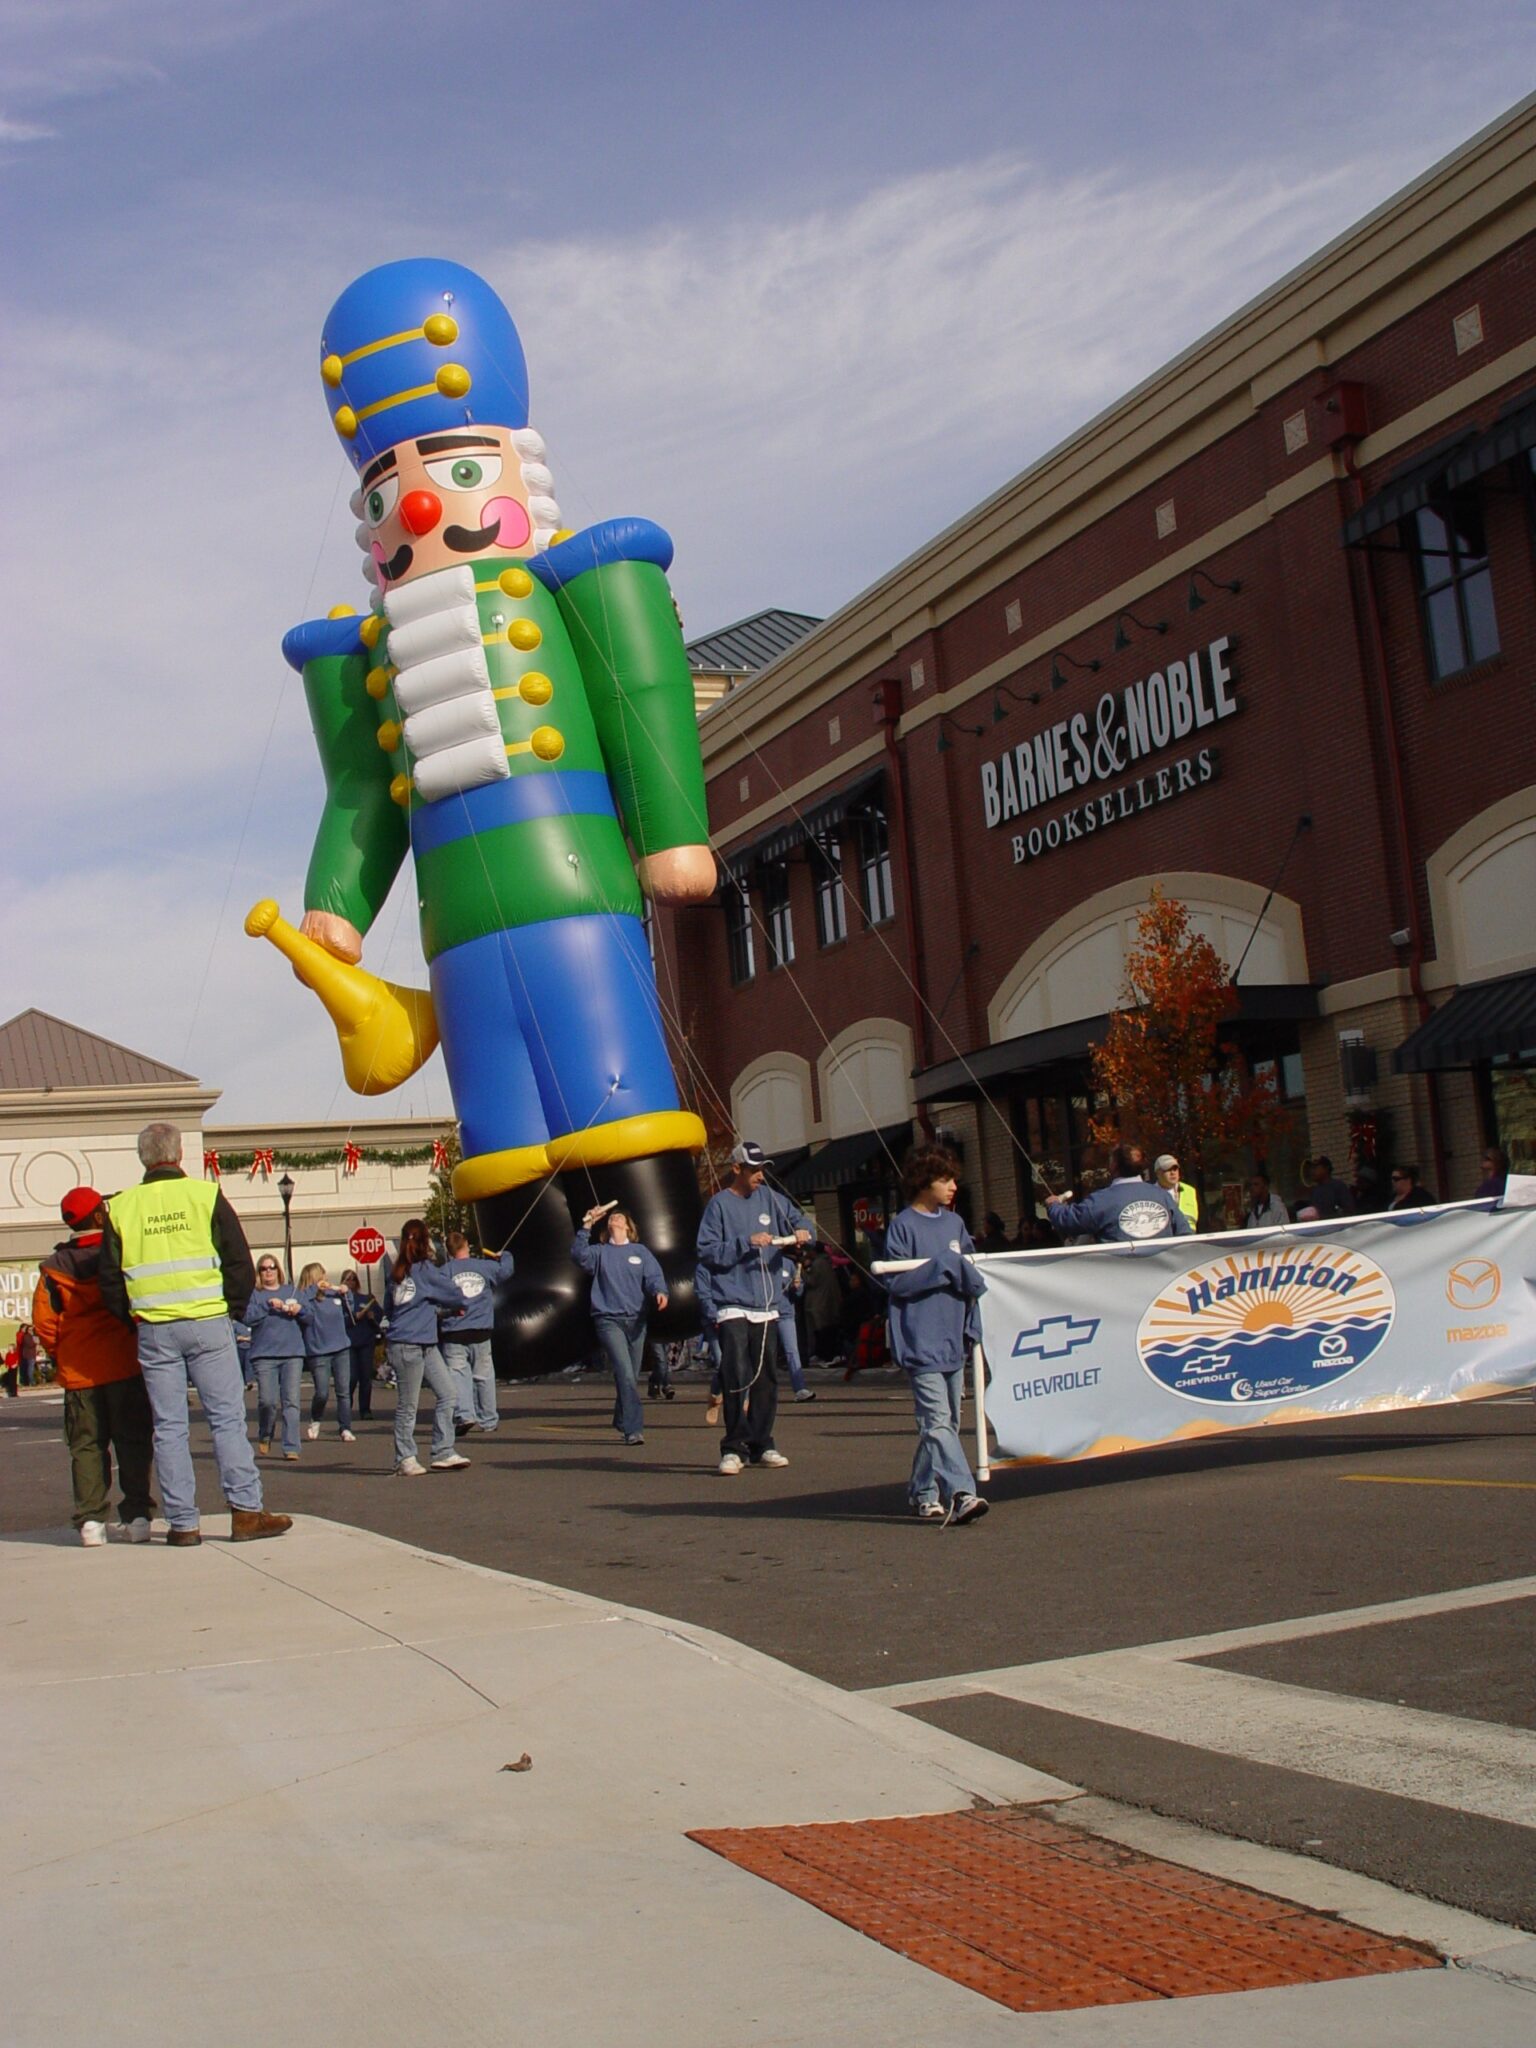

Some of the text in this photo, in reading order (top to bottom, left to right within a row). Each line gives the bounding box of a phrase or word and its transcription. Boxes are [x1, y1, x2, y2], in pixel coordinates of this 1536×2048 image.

[1012, 749, 1212, 864] BOOKSELLERS
[147, 1211, 186, 1224] PARADE
[144, 1223, 192, 1236] MARSHAL
[351, 1238, 383, 1254] STOP
[1186, 1262, 1358, 1315] Hampton
[1012, 1367, 1102, 1401] CHEVROLET
[1174, 1371, 1239, 1388] CHEVROLET
[1254, 1379, 1277, 1389] Used
[1277, 1377, 1295, 1386] Car
[1253, 1389, 1281, 1398] Super
[1280, 1384, 1310, 1394] Center
